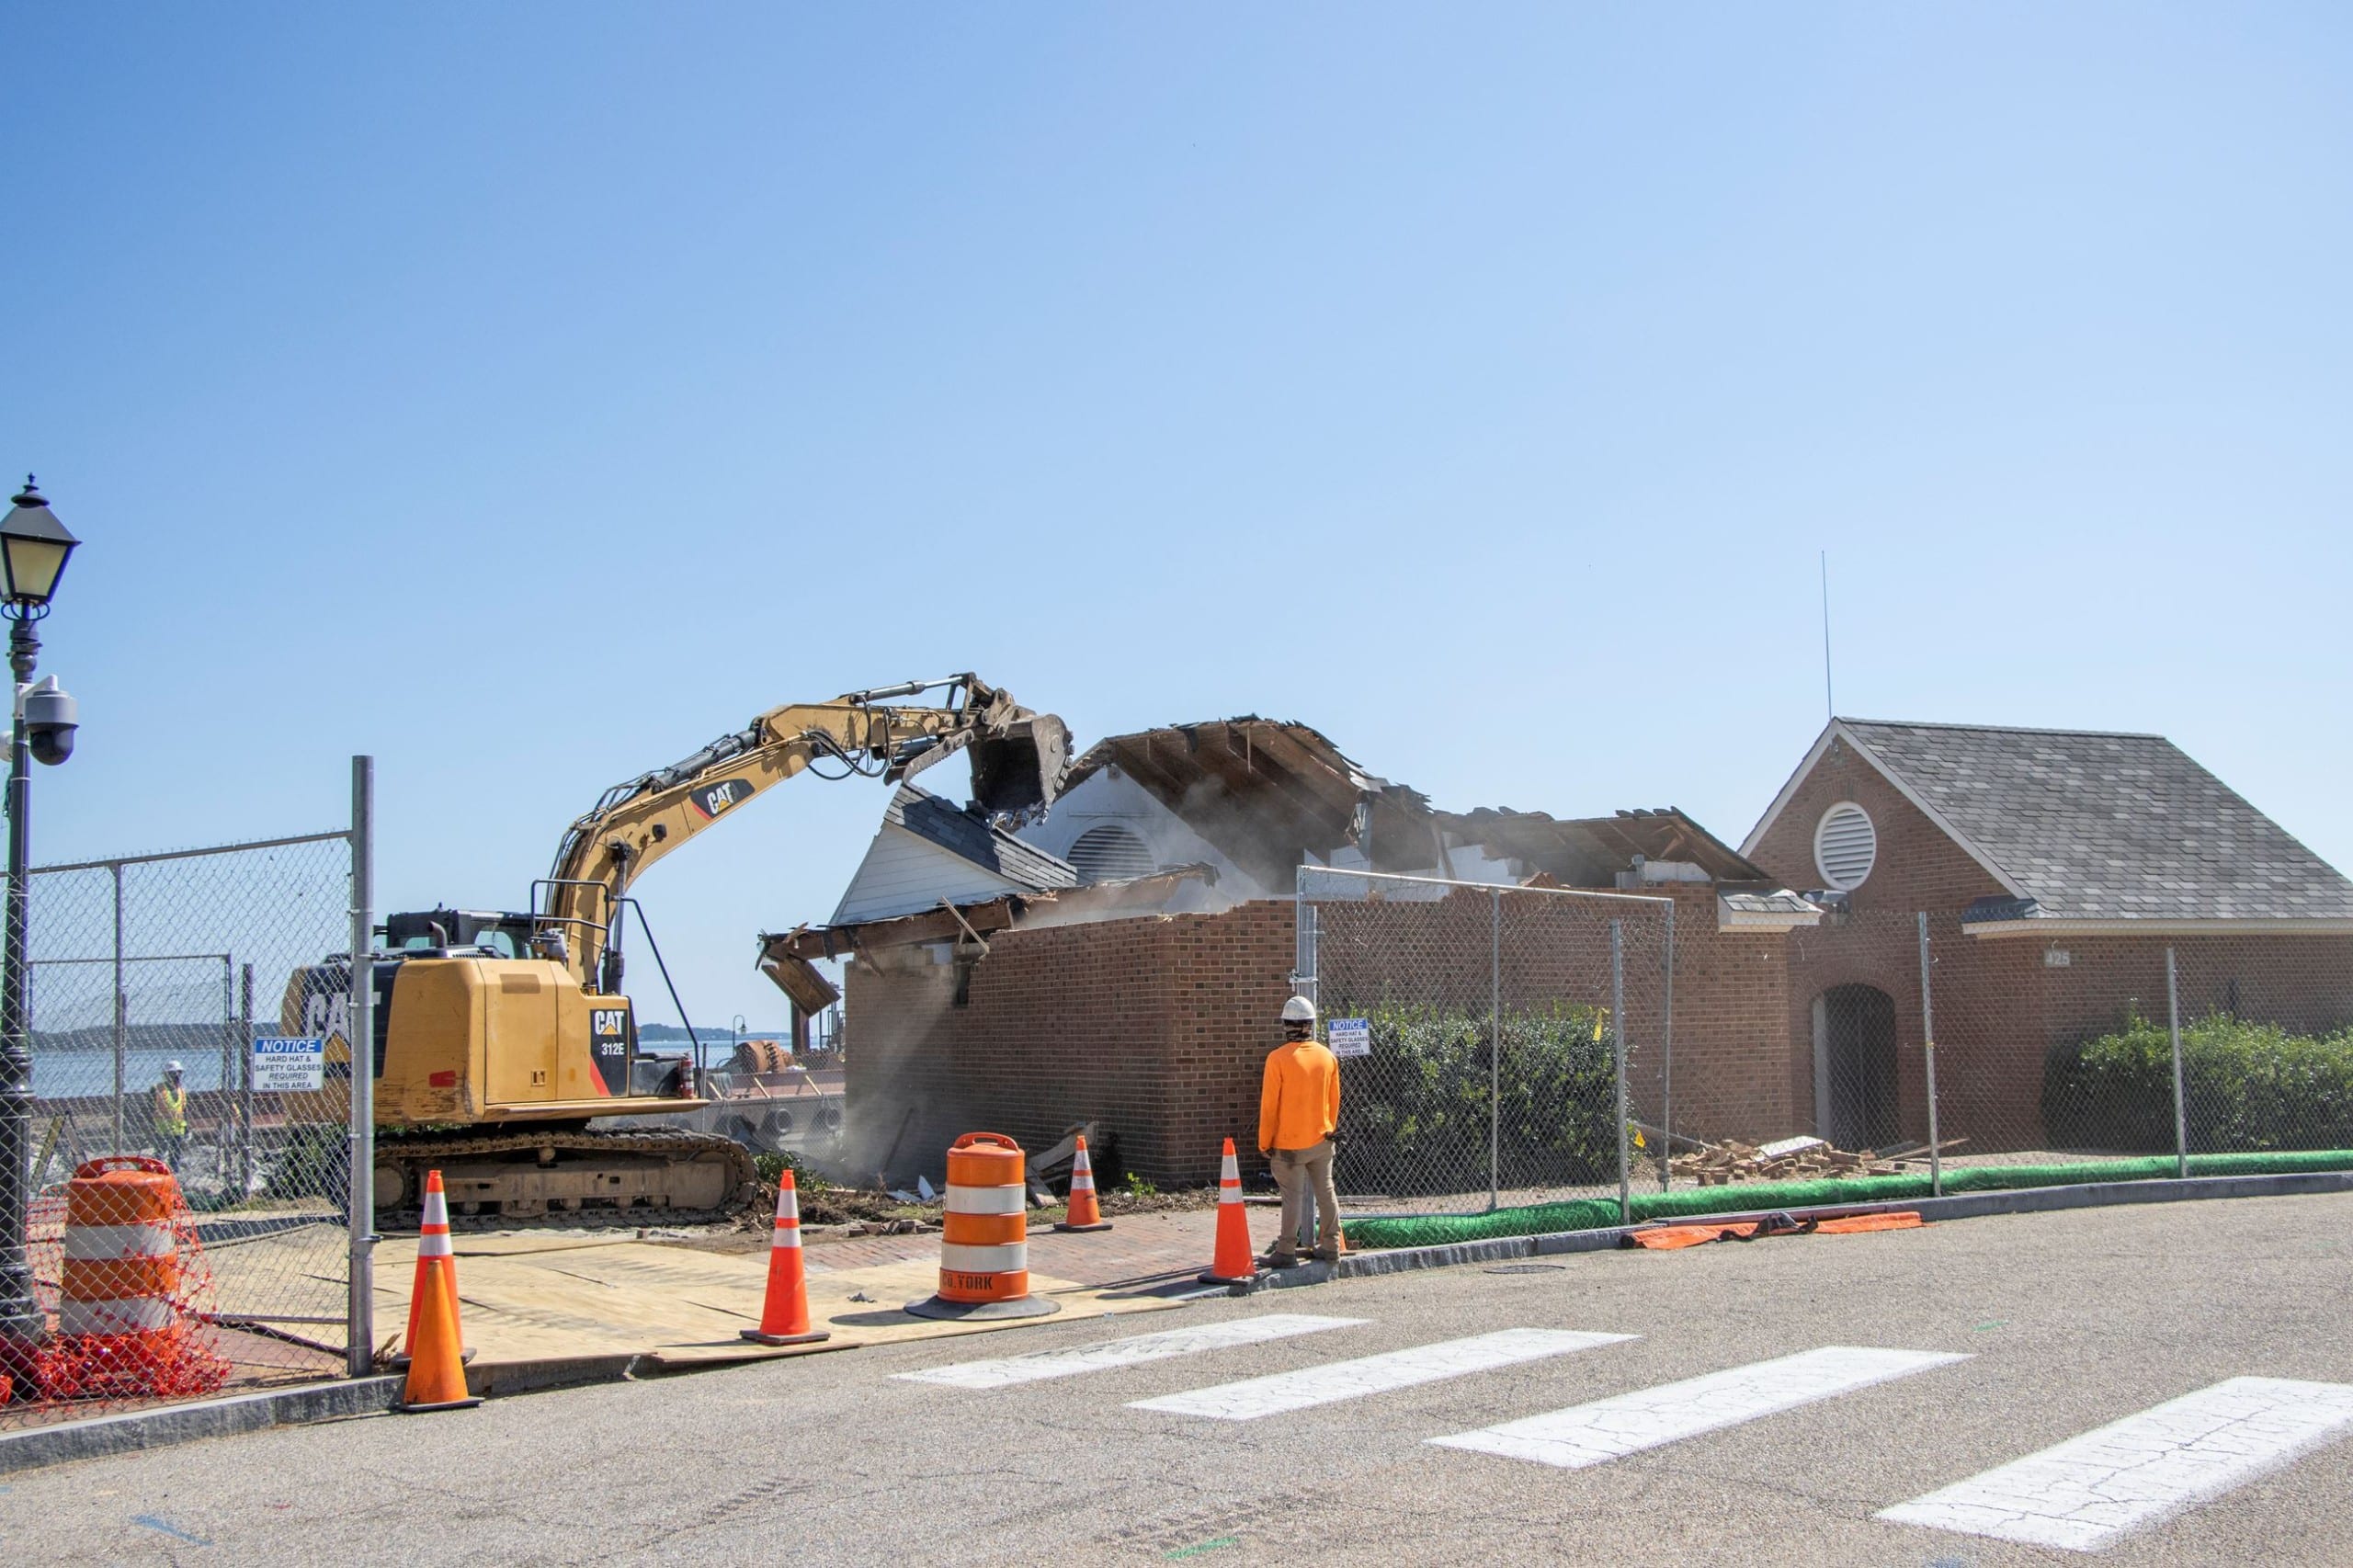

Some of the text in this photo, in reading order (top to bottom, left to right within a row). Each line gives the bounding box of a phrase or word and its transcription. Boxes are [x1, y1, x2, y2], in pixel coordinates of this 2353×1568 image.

[707, 782, 733, 814] CAT
[595, 1011, 624, 1035] CAT
[1333, 1020, 1364, 1030] NOTICE
[261, 1040, 316, 1052] NOTICE
[601, 1042, 624, 1055] 312E
